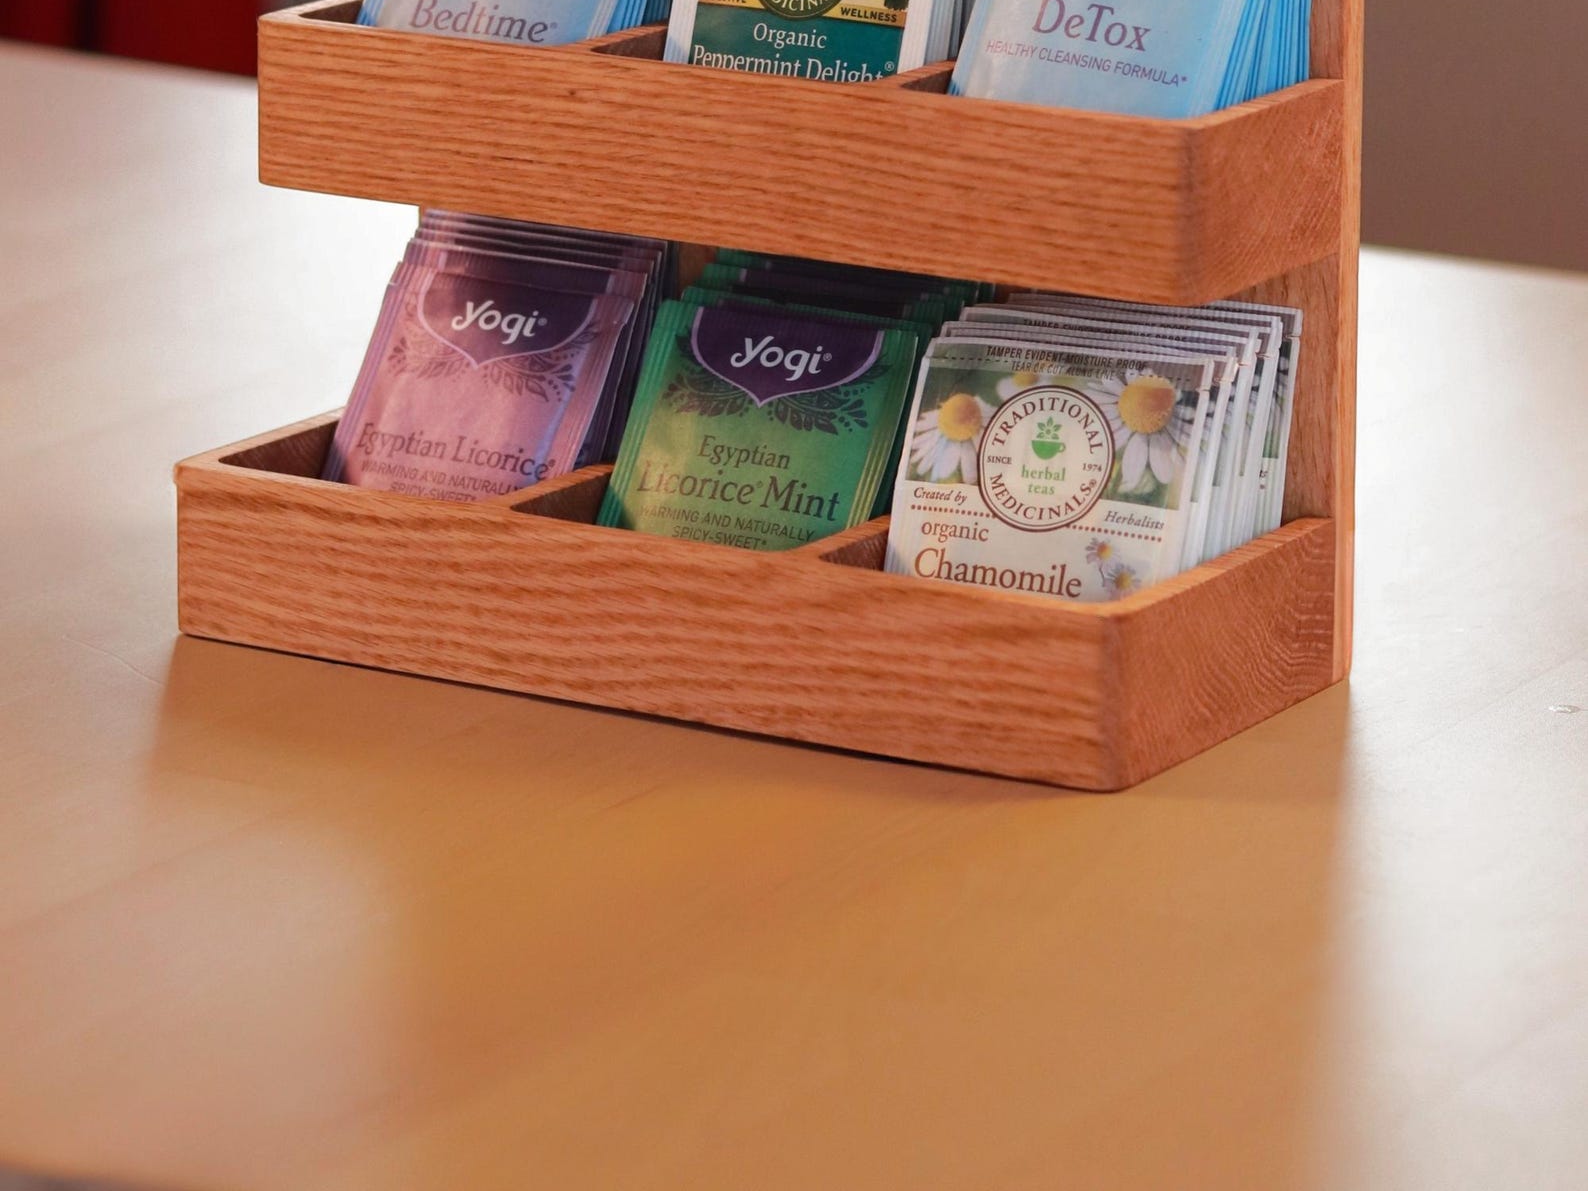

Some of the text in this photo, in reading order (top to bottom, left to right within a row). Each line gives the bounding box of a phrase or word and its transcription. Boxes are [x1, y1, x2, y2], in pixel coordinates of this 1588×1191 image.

[840, 6, 898, 24] WELLNESS
[753, 22, 828, 49] Organic
[693, 44, 801, 78] Peppermint
[985, 39, 1039, 58] HEALTHY
[1038, 47, 1112, 73] CLEANSING
[986, 345, 1022, 359] TAMPER
[1116, 359, 1149, 372] PROOF
[1010, 360, 1116, 381] TEAR OR CUT ALONG LINE
[991, 397, 1103, 454] TRADITIONAL
[357, 422, 447, 460] Egyptian
[697, 434, 791, 470] Egyptian
[987, 455, 1012, 465] SINCE
[1021, 464, 1066, 482] herbal
[1082, 463, 1103, 473] 1974
[361, 460, 523, 497] WARMING AND NATURAL
[1028, 483, 1055, 496] teas
[759, 475, 841, 522] Mint
[913, 487, 968, 505] Created by
[640, 505, 816, 543] WARMING AND NATURALLY
[921, 520, 990, 544] organic
[1103, 510, 1165, 531] Herbalists
[914, 547, 1083, 599] Chamomile
